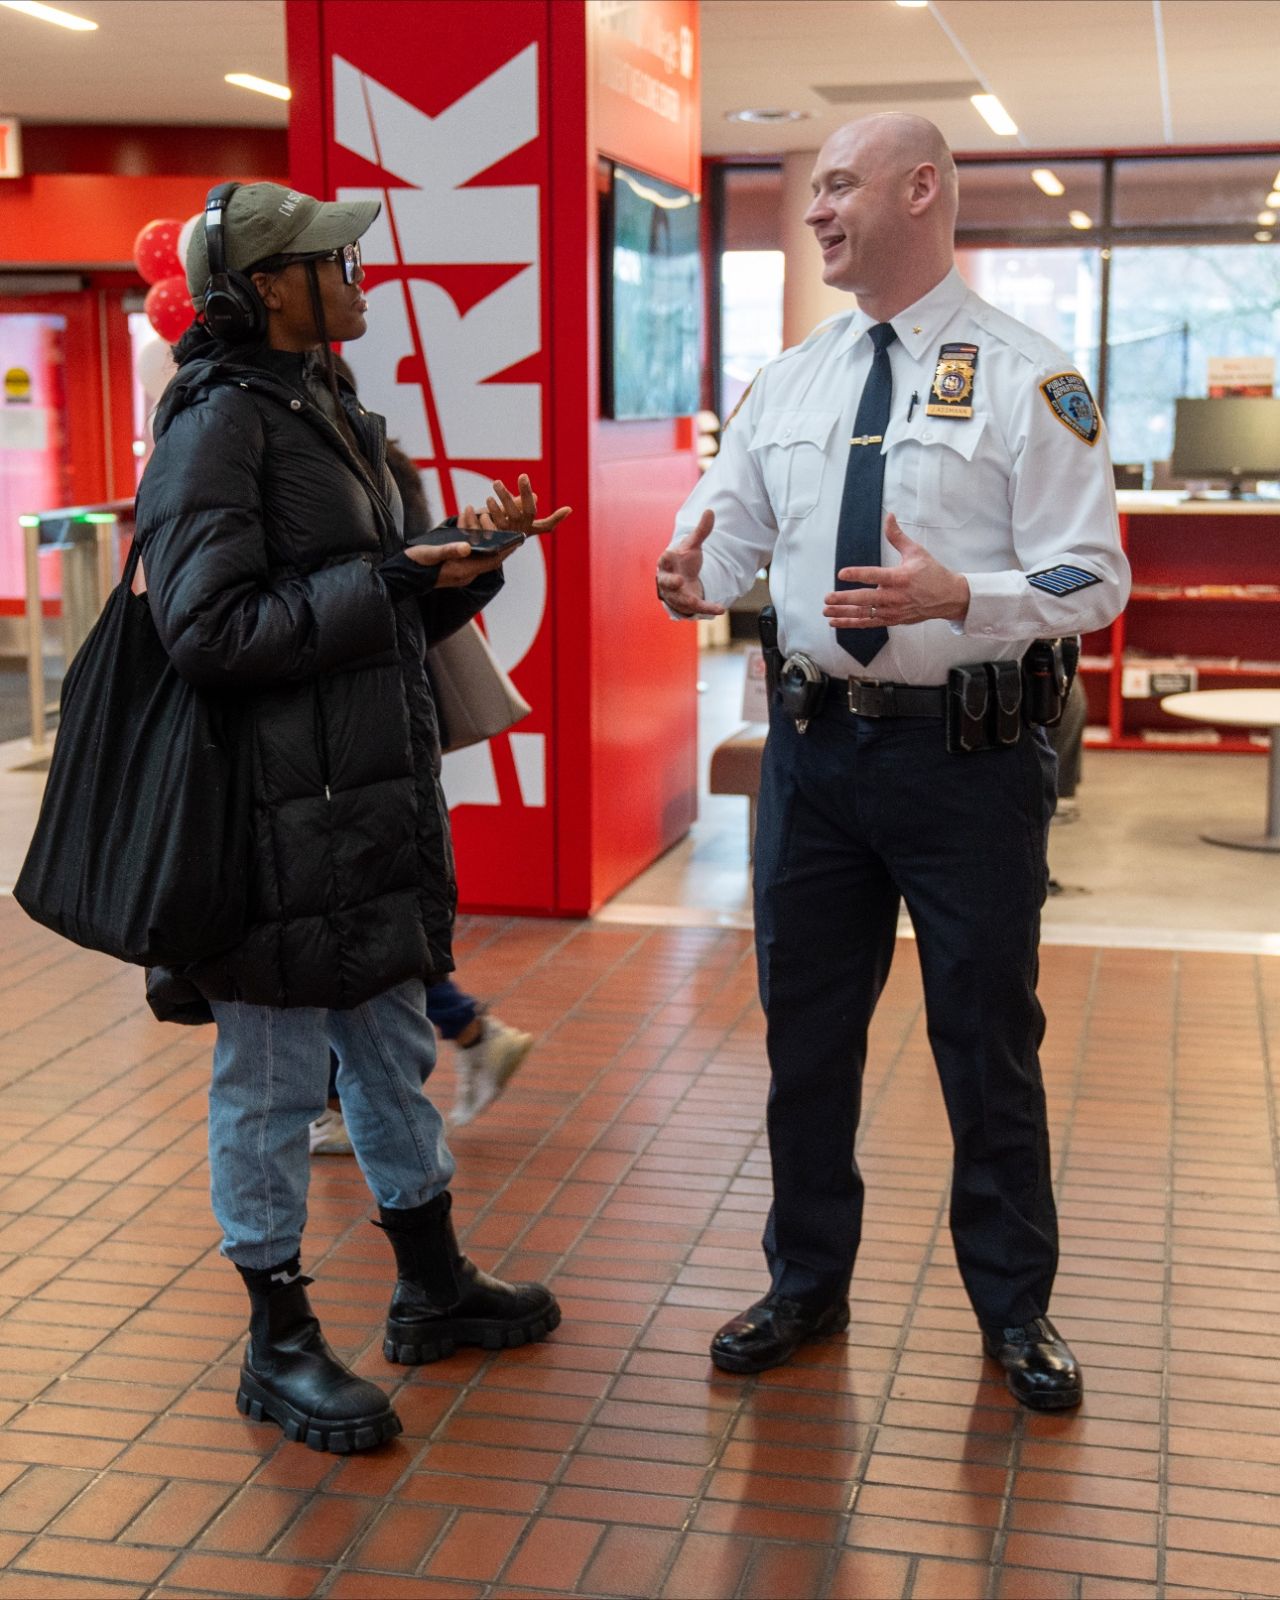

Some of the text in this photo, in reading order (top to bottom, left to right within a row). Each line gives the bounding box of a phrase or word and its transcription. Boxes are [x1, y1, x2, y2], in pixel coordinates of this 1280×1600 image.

[1046, 377, 1068, 392] PUBLIC
[1052, 400, 1063, 414] CITY
[333, 41, 546, 807] RK
